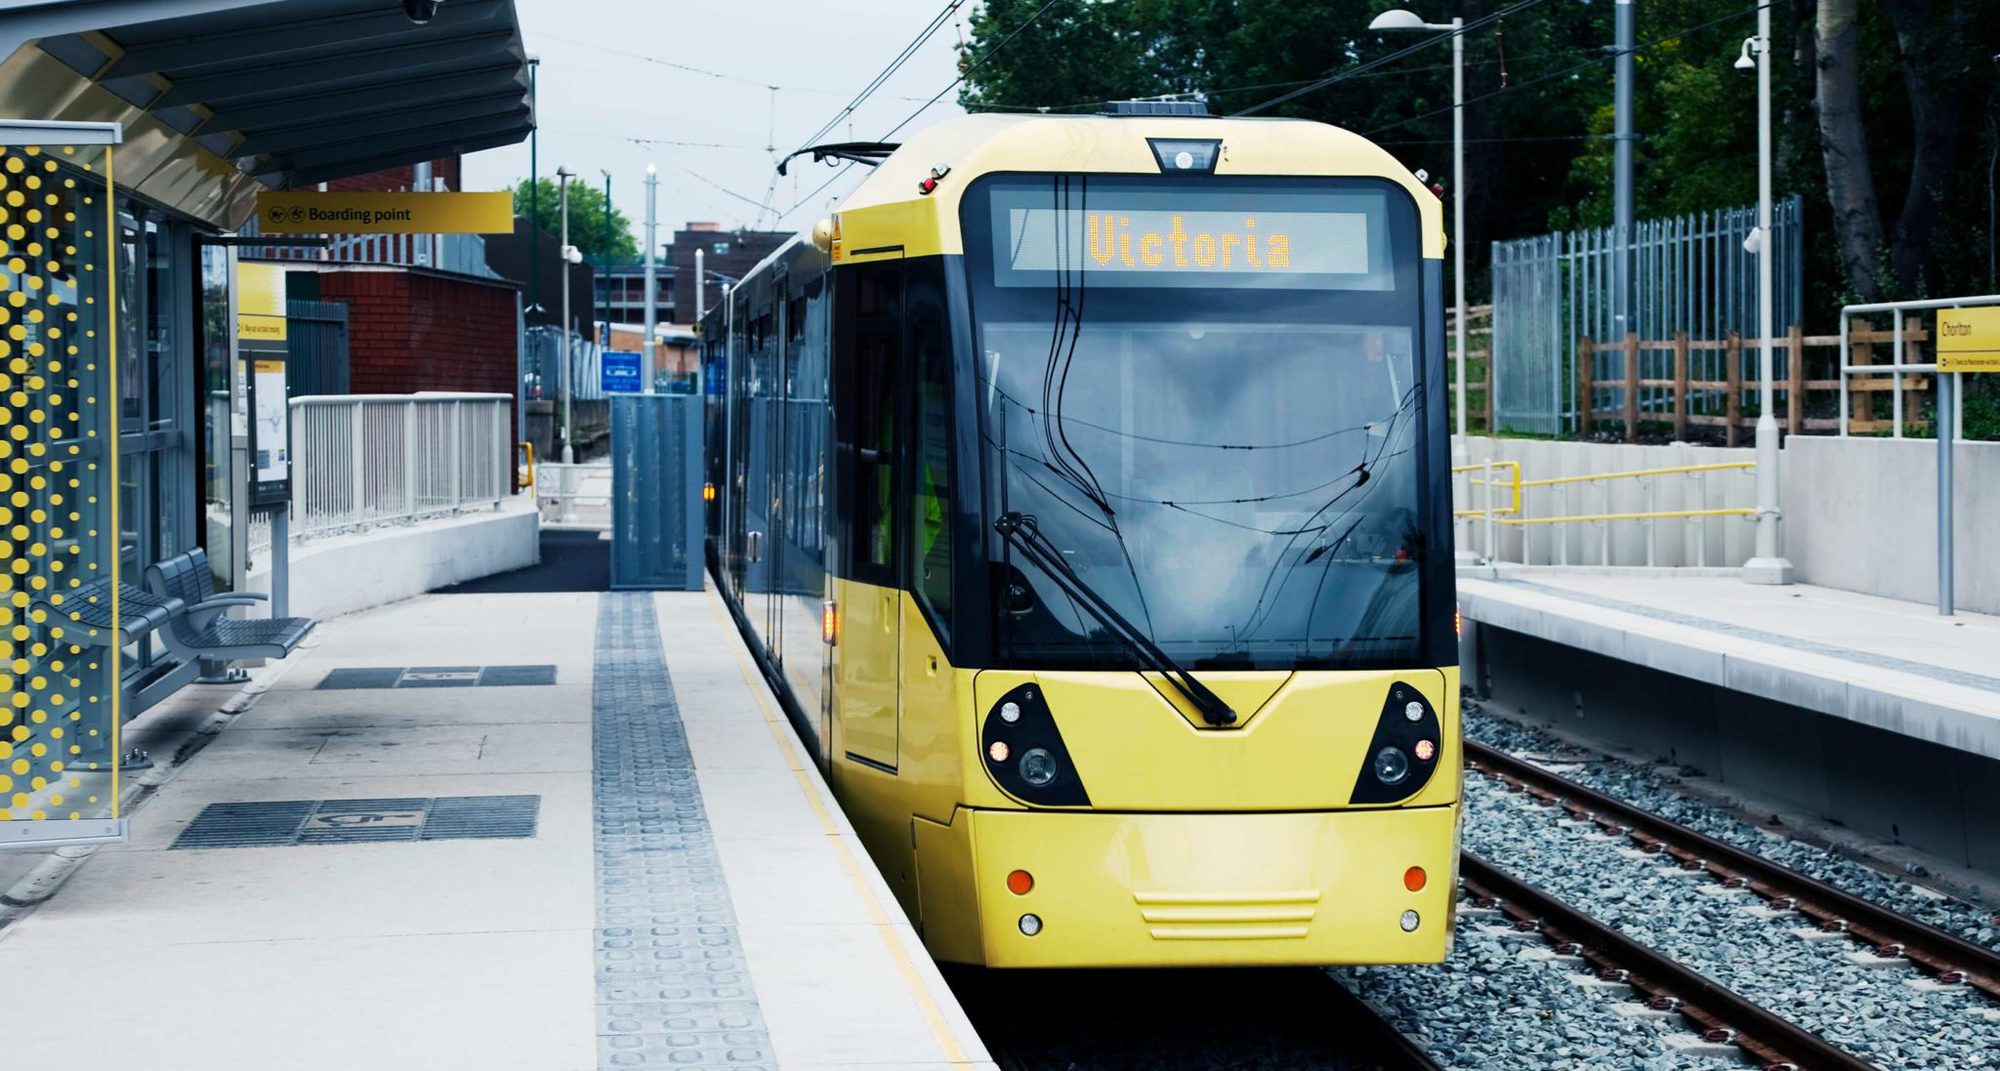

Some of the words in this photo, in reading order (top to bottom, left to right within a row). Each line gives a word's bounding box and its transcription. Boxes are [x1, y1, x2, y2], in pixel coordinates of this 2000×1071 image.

[309, 207, 371, 224] Boarding
[374, 208, 412, 224] point
[1089, 215, 1290, 268] Victoria
